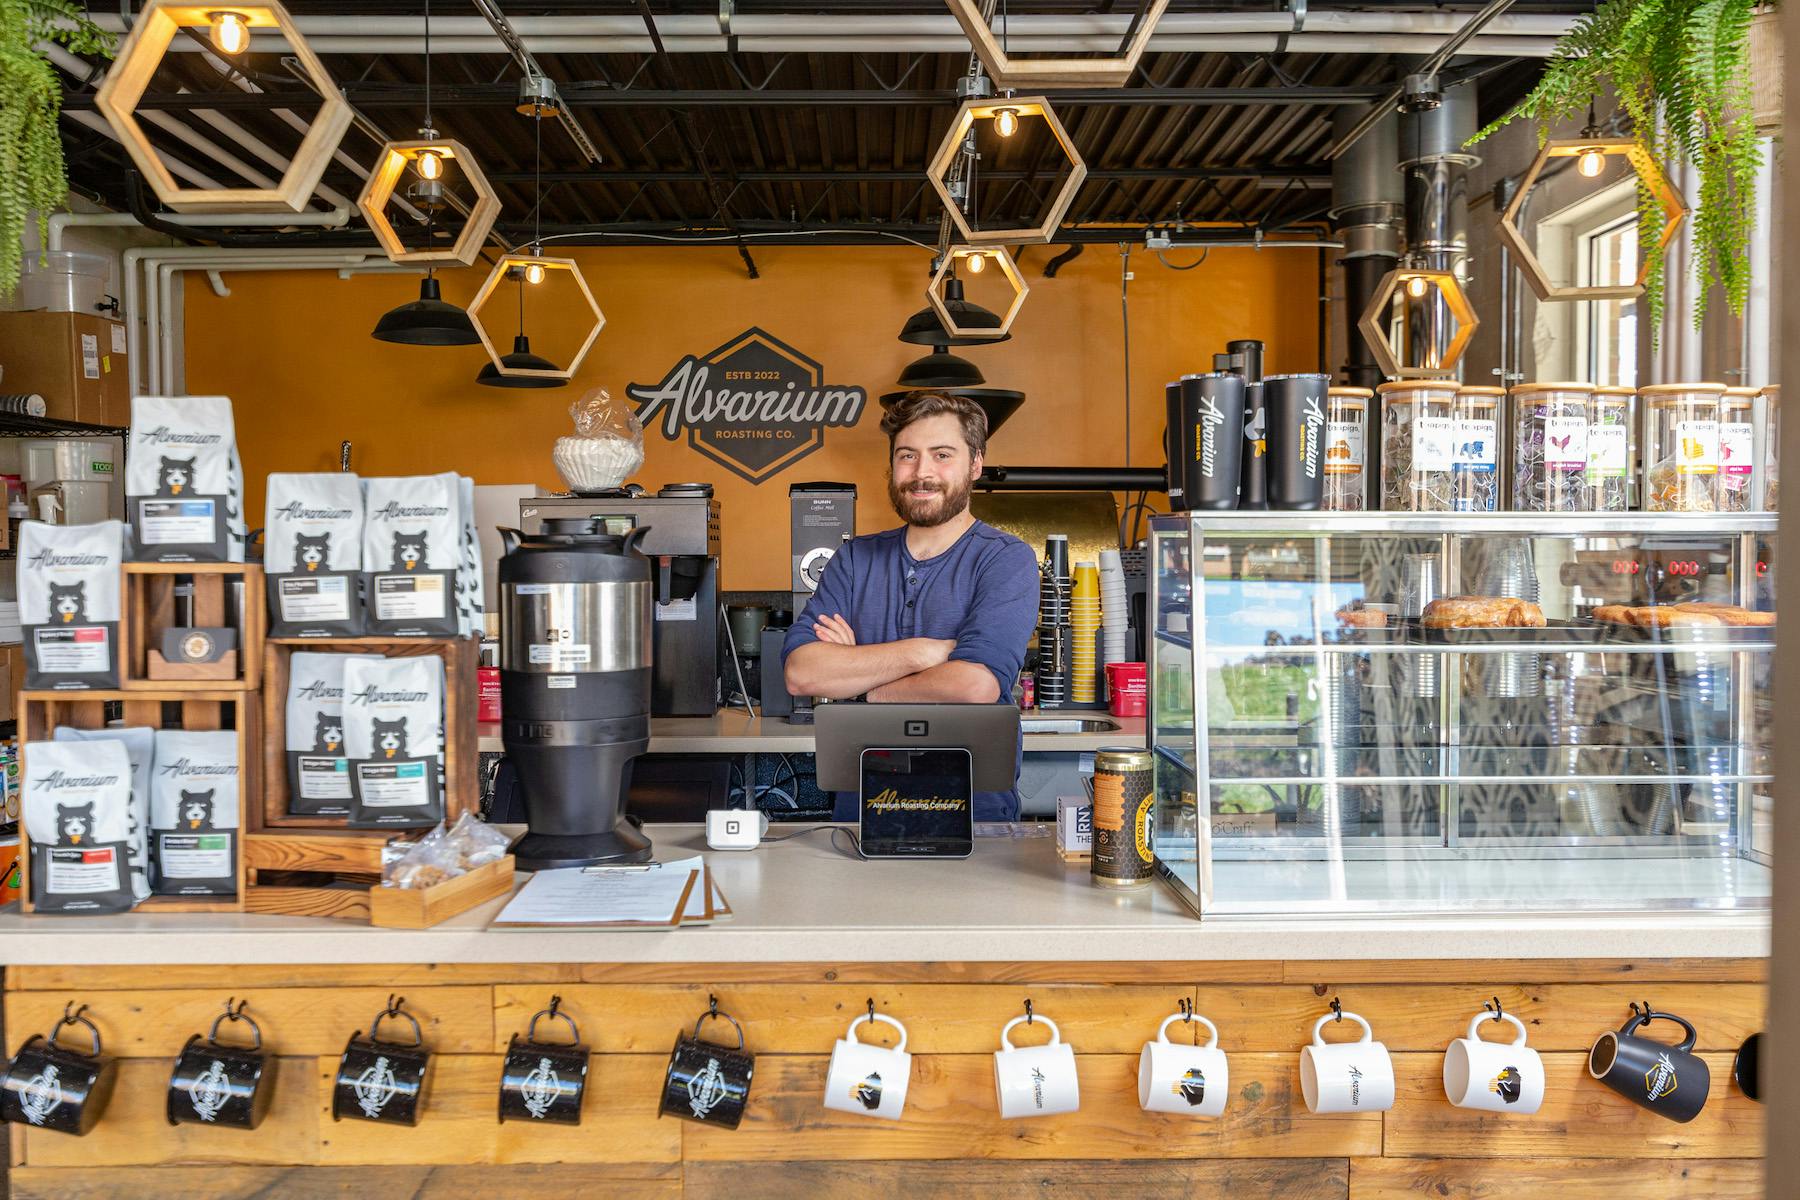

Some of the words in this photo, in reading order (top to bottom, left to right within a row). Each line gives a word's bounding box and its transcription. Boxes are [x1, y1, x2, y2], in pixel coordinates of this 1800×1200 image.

[725, 371, 752, 380] ESTB
[754, 371, 780, 380] 2022
[630, 360, 862, 436] Alvarium
[139, 426, 222, 446] Alvarium
[715, 430, 772, 439] ROASTING
[775, 430, 796, 439] CO.
[1197, 395, 1225, 478] Alvarium
[1302, 396, 1325, 478] Alvarium
[275, 500, 353, 521] Alvarium
[373, 500, 449, 522] Alvarium
[27, 547, 108, 570] Alvarium
[350, 684, 429, 707] Alvarium
[159, 757, 240, 776] Alvarium
[32, 769, 119, 792] Alvarium
[872, 801, 900, 809] Alvarium
[901, 801, 929, 810] Roasting
[930, 801, 960, 811] Company
[1031, 1066, 1046, 1110] Alvarium
[1348, 1064, 1363, 1106] Alvarium
[1647, 1052, 1675, 1102] Alvarium
